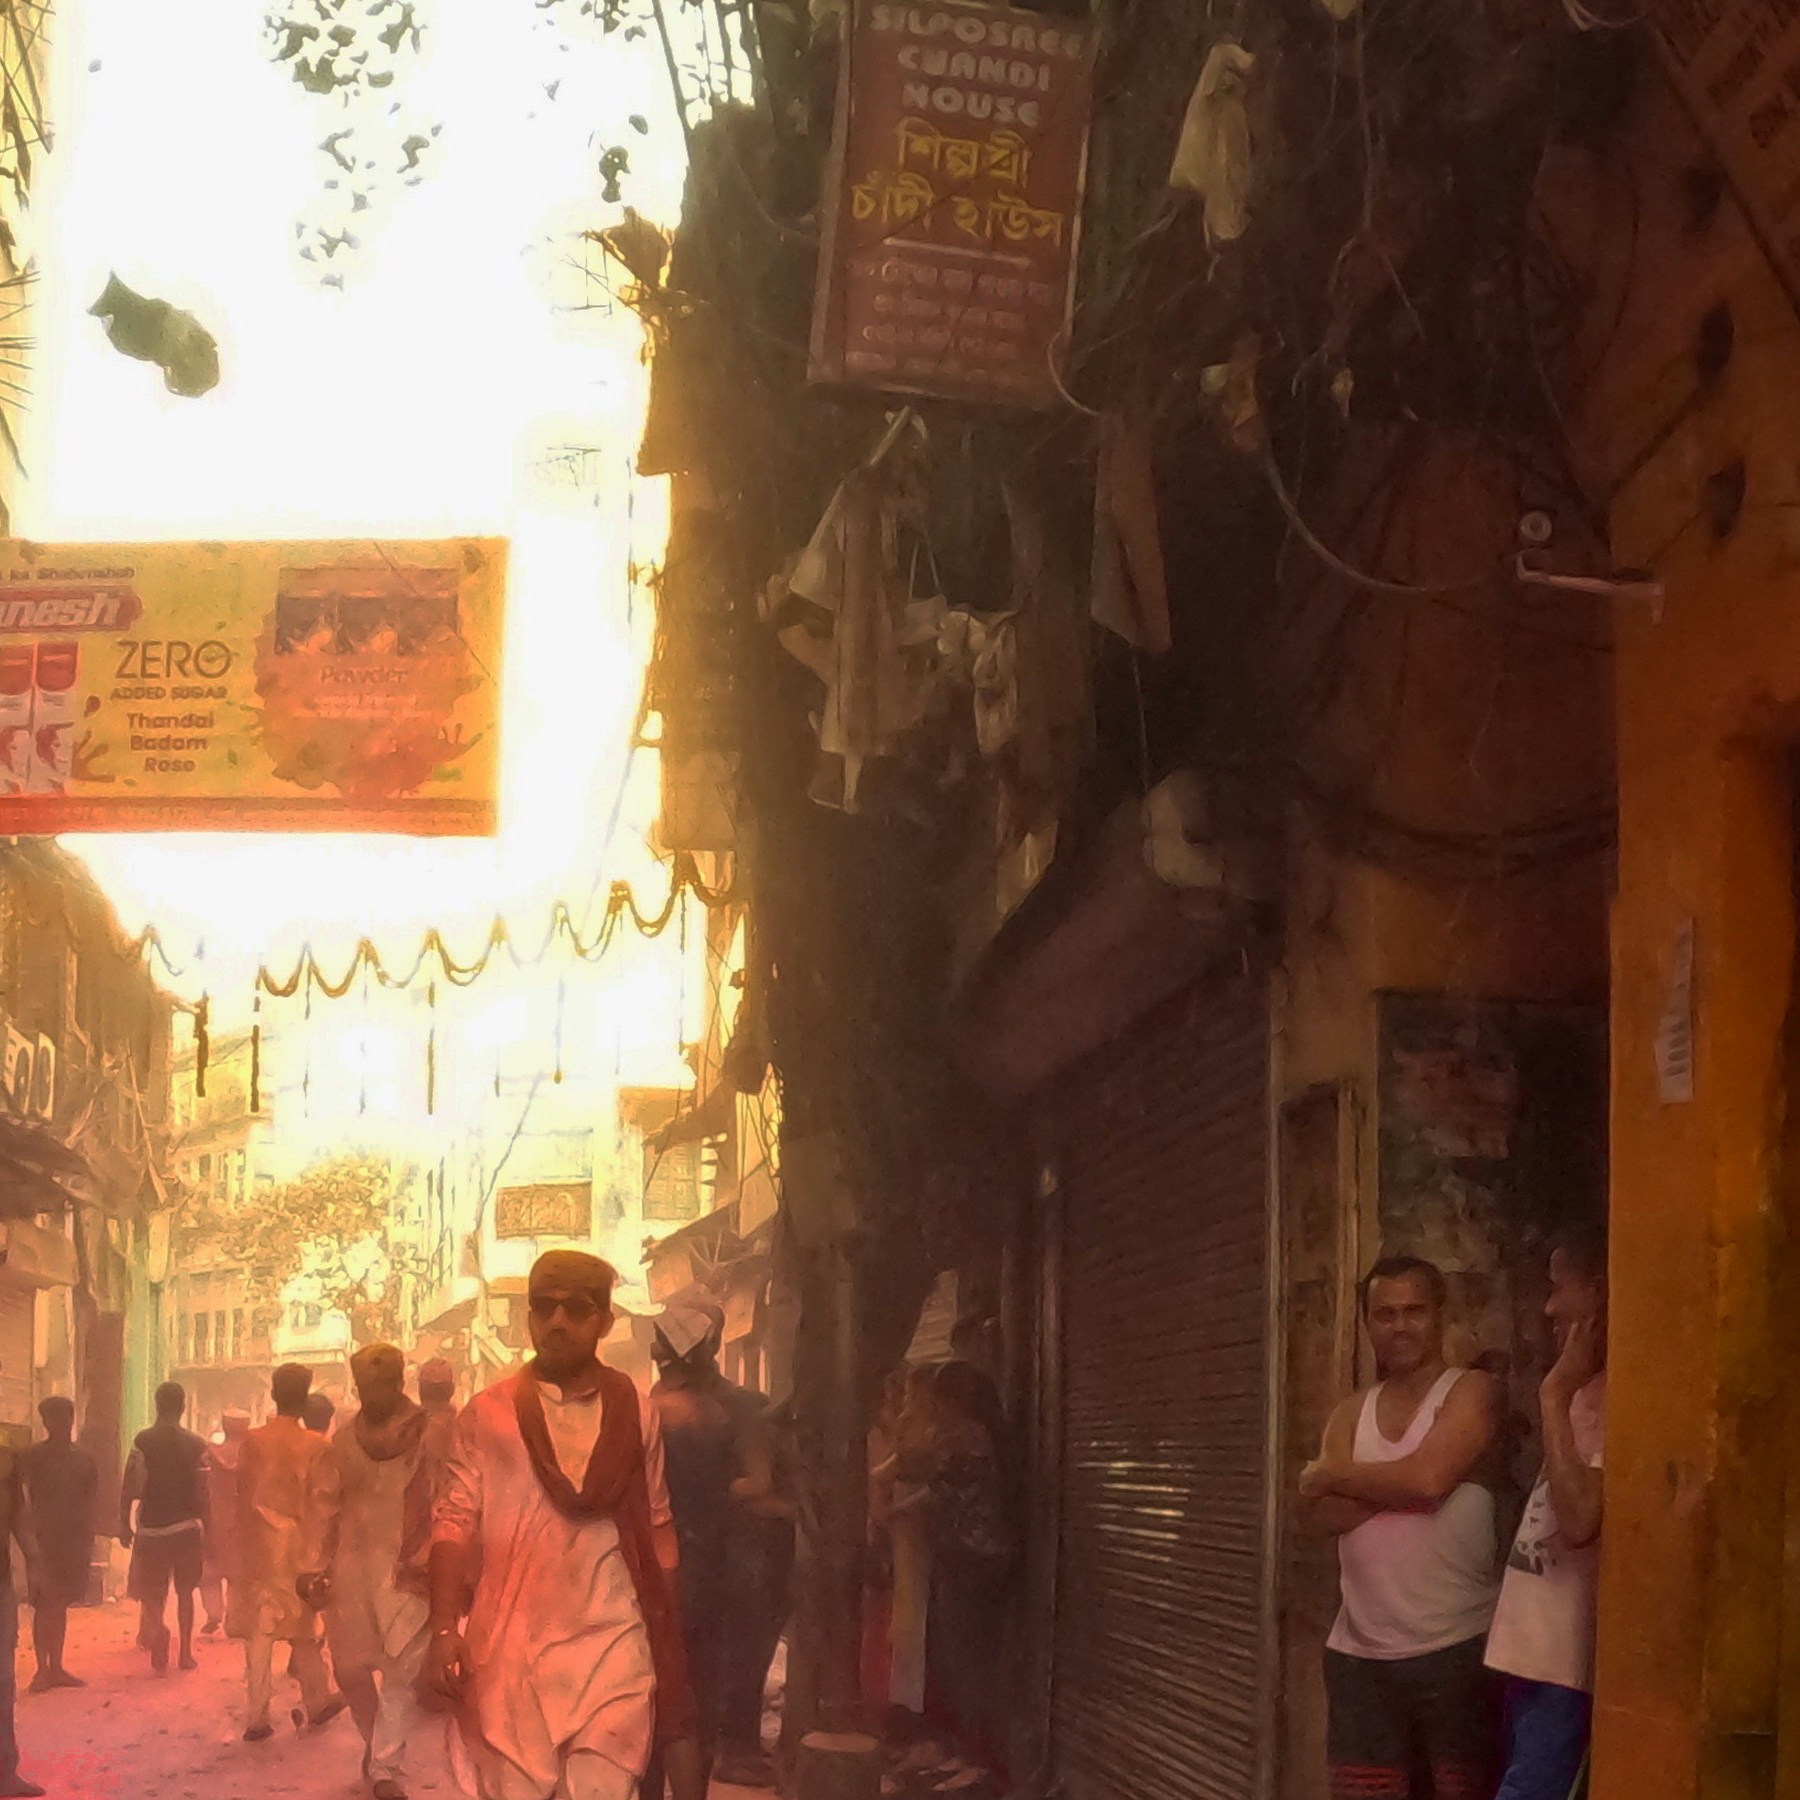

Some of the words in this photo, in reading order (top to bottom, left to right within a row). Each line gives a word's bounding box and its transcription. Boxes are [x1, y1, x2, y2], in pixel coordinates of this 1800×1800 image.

[903, 82, 1040, 129] HOUSE
[114, 640, 235, 678] ZERO
[111, 686, 167, 700] ADDED
[171, 686, 229, 700] SUGAR
[126, 711, 215, 729] Thandai
[130, 734, 208, 751] Badam
[144, 757, 197, 773] Rose
